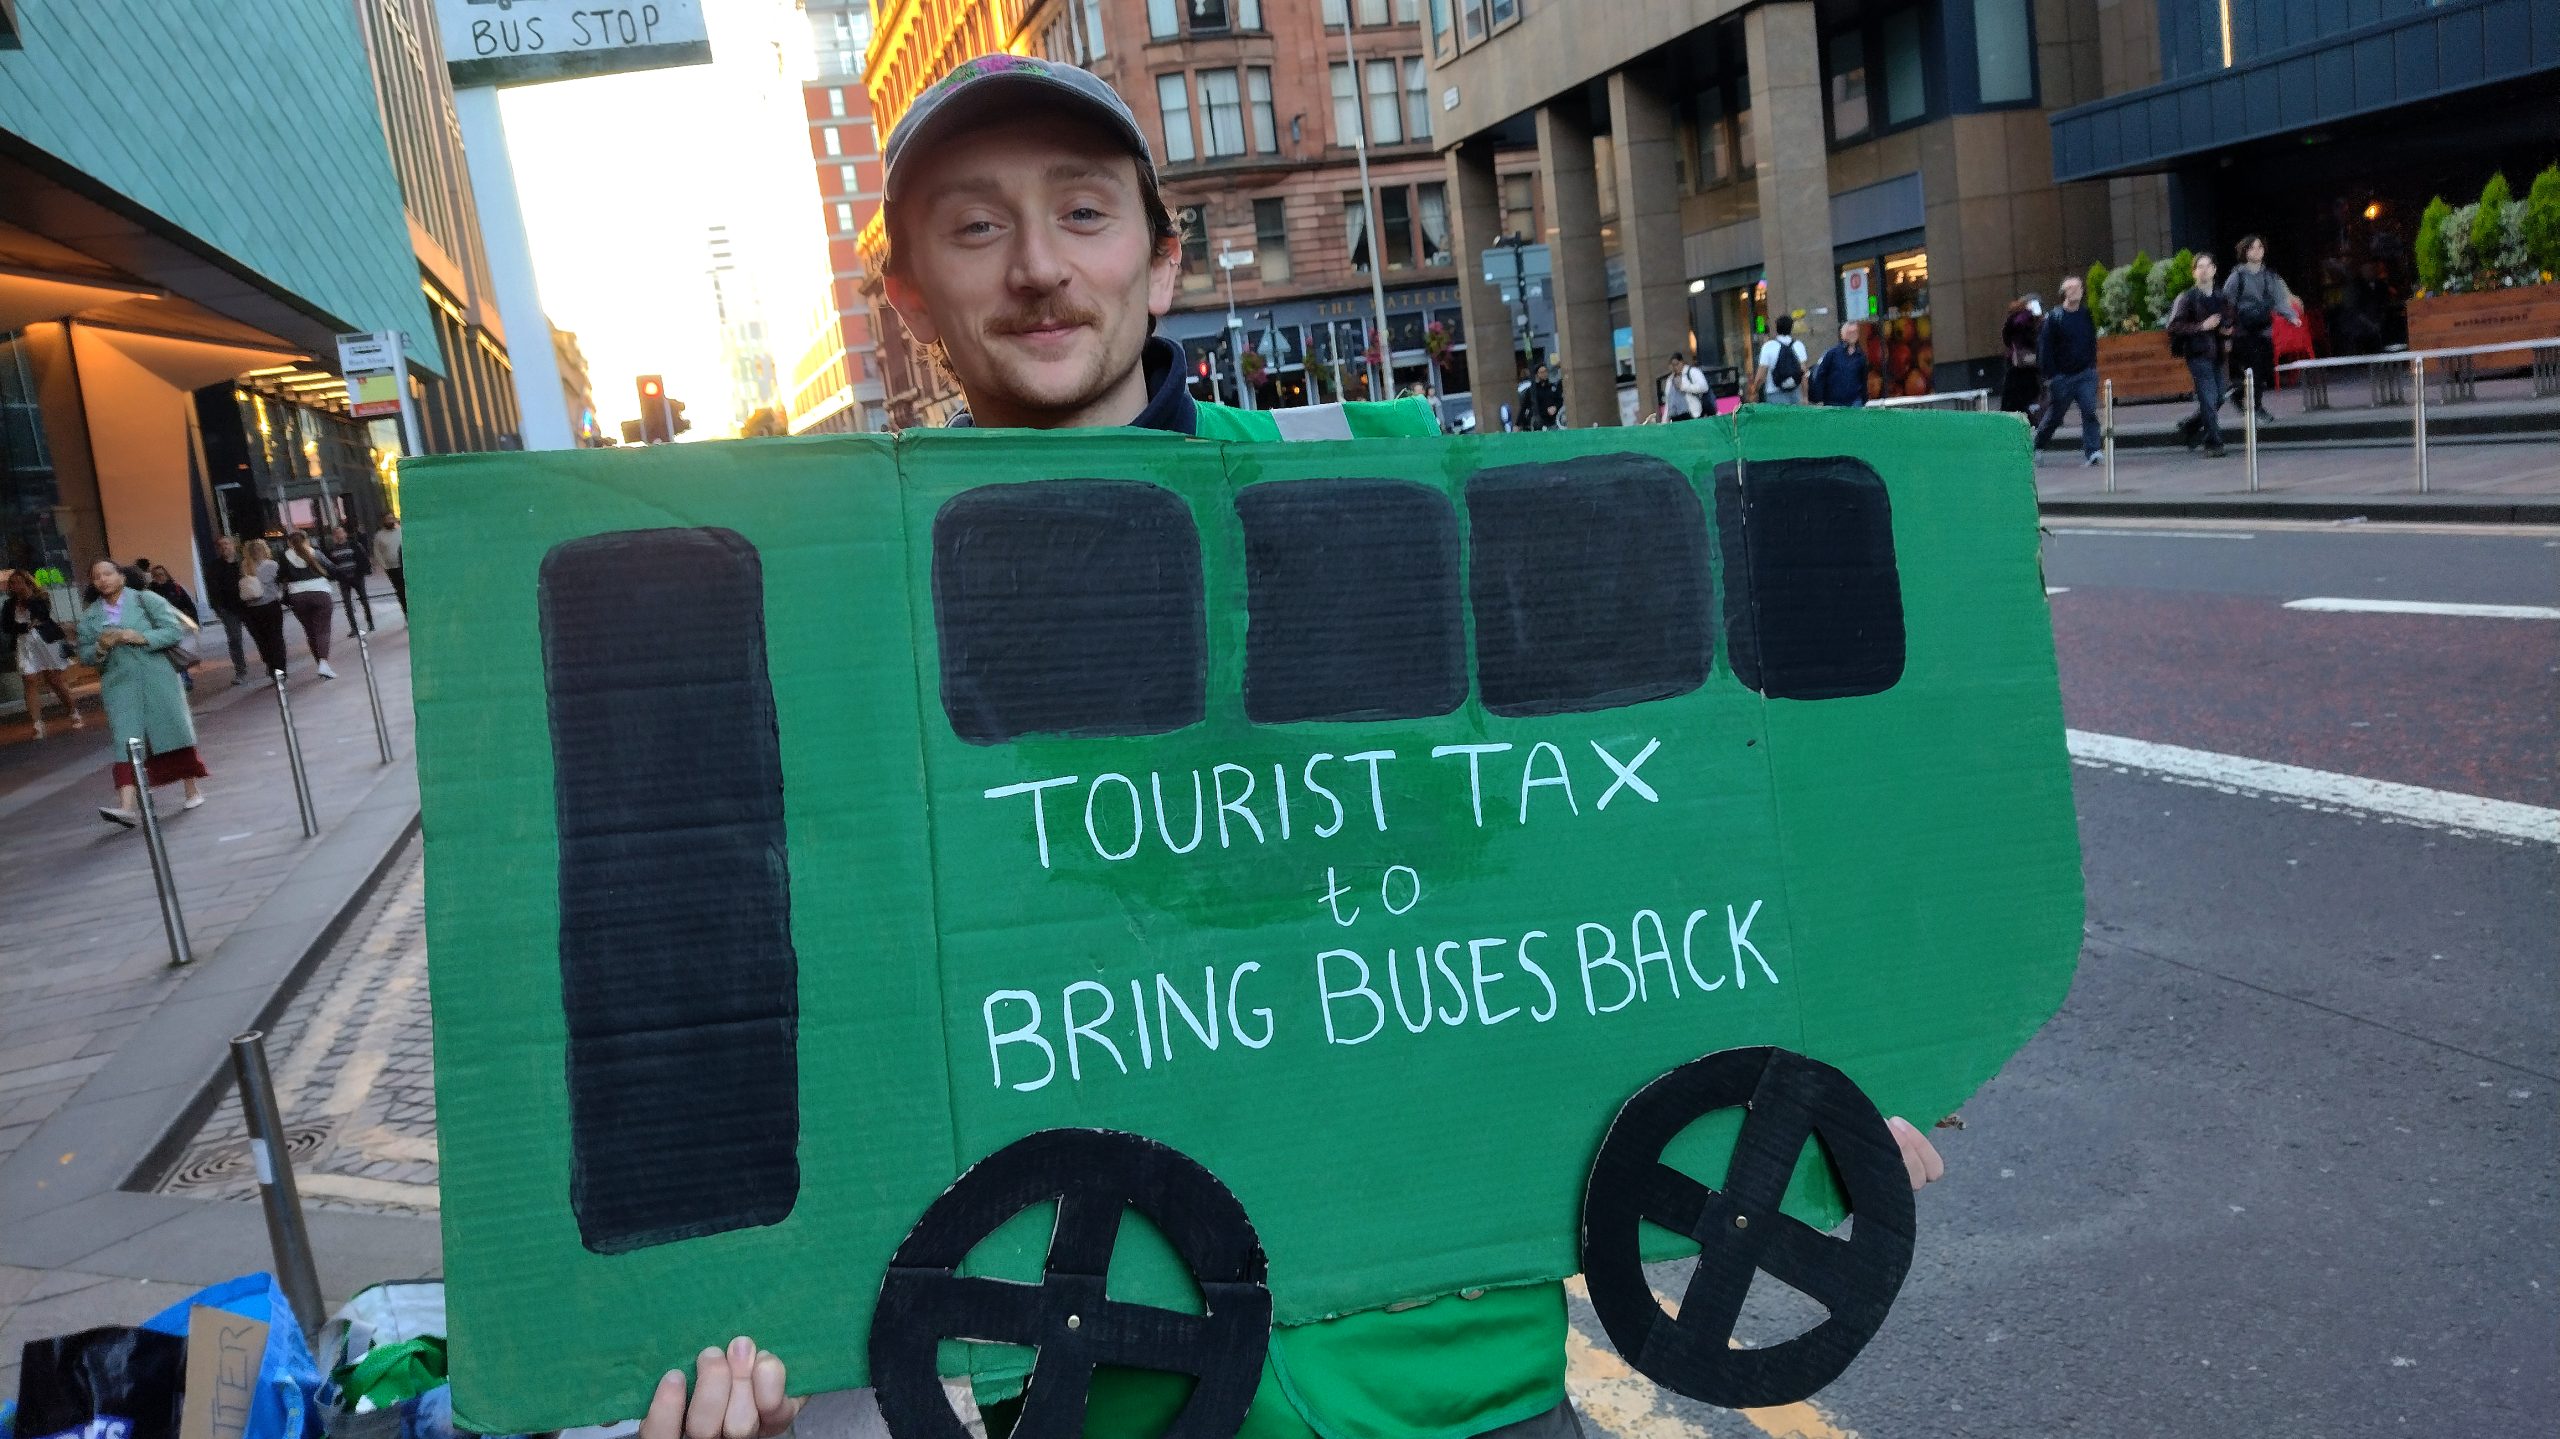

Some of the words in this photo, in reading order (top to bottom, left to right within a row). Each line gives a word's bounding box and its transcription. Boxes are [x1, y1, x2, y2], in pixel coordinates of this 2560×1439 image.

[472, 17, 544, 55] BUS
[571, 5, 660, 47] STOP
[1317, 301, 1355, 316] THE
[984, 749, 1397, 869] TOURIST
[1431, 736, 1661, 828] TAX
[1318, 865, 1421, 927] to
[983, 961, 1274, 1092] BRING
[1316, 930, 1558, 1045] BUSES
[1576, 899, 1780, 1016] BACK
